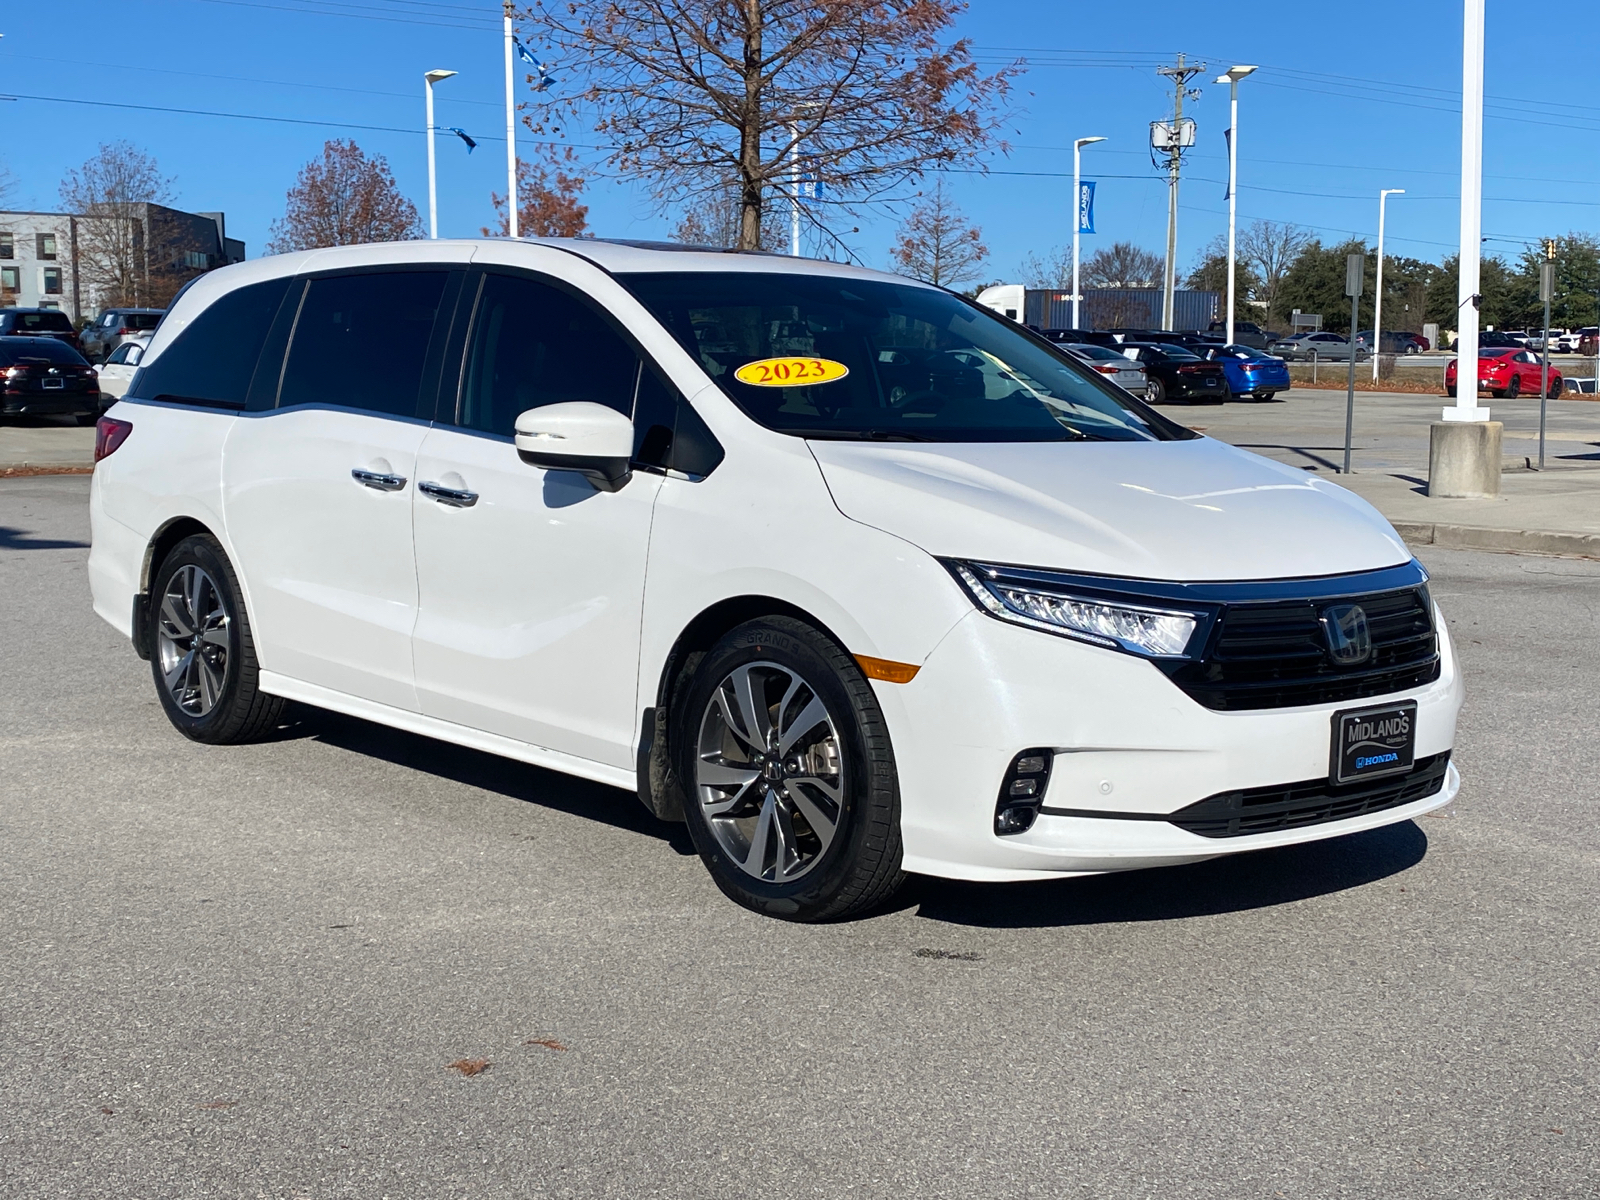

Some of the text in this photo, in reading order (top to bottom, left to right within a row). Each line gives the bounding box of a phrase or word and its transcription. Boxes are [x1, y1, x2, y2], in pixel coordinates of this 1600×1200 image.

[755, 360, 825, 382] 2023
[1348, 716, 1410, 742] MIDLANDS
[1364, 753, 1398, 766] HONDA
